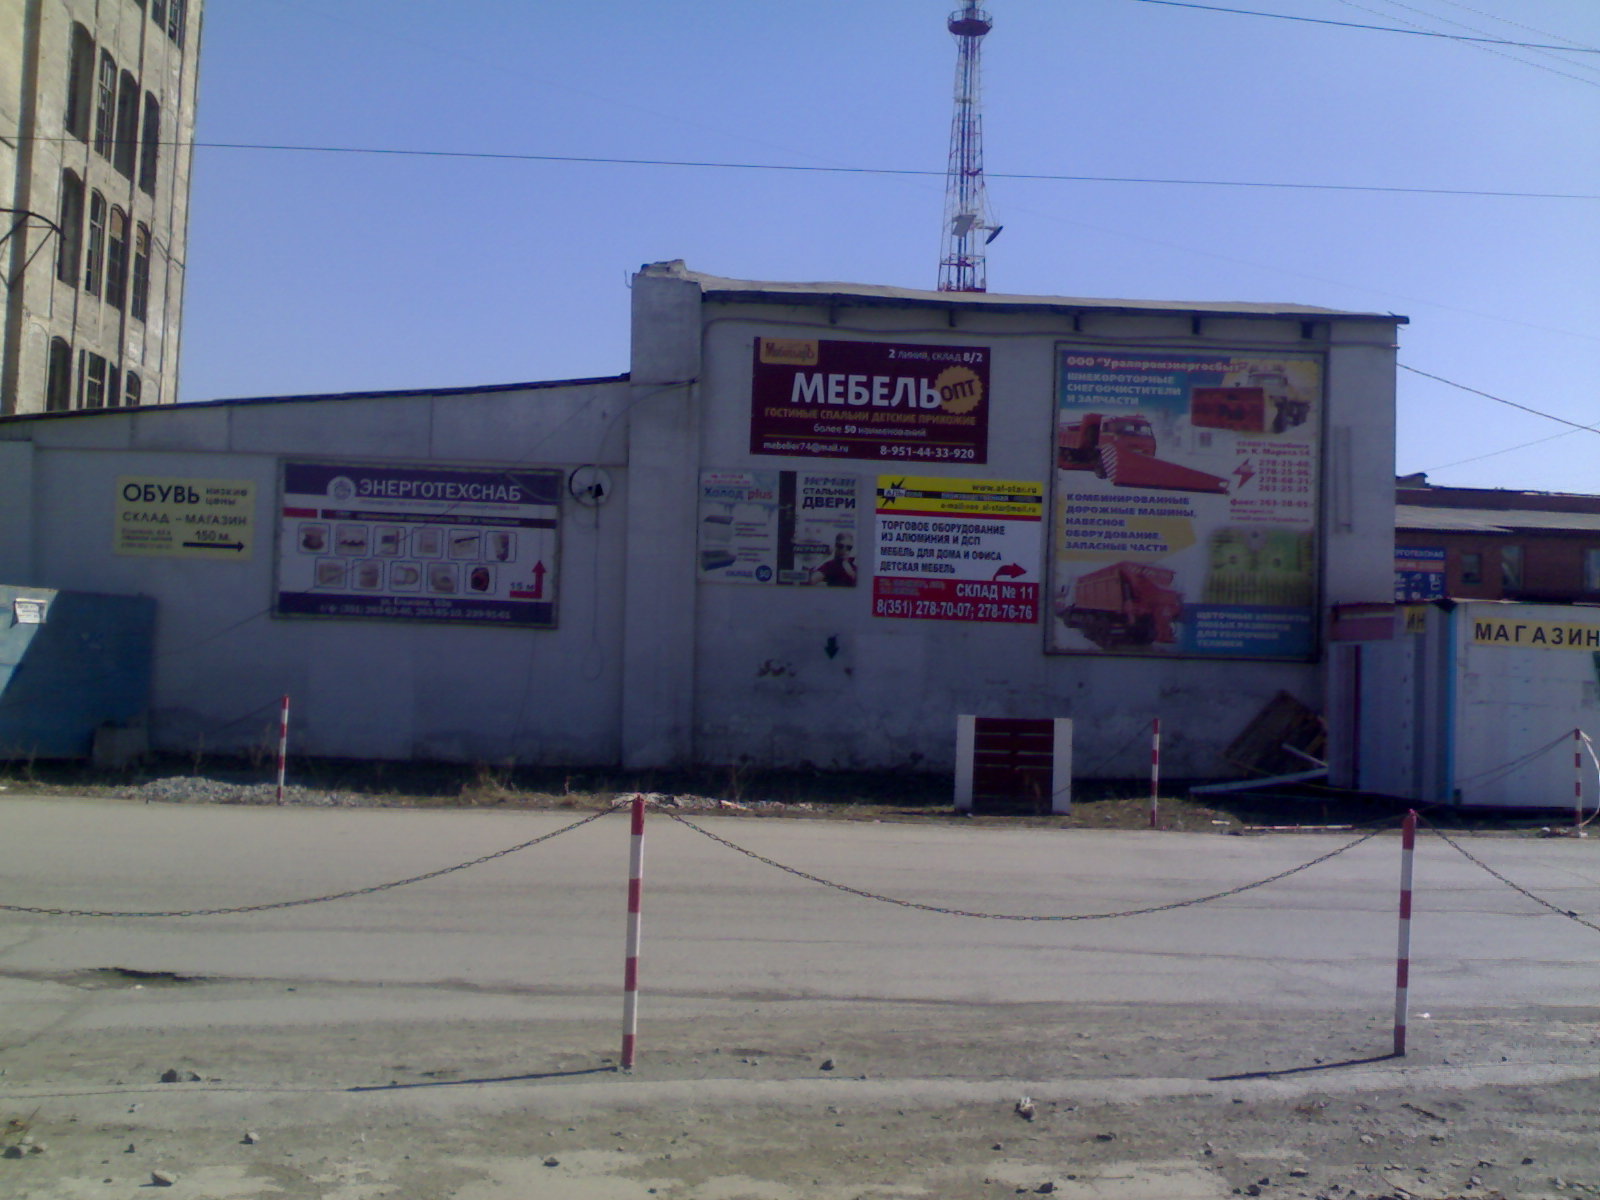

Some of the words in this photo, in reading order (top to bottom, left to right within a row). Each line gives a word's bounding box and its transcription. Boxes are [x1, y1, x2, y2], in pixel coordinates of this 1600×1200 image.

[888, 349, 896, 359] 2
[1067, 356, 1095, 367] ООО
[791, 371, 943, 410] МЕБЕЛЬ
[940, 379, 977, 402] ОПТ
[844, 425, 857, 435] 50
[880, 446, 975, 460] 8-951-44-33-920
[123, 483, 200, 504] ОБУВЬ
[359, 479, 521, 502] ЭНЕРГОТЕХСНАБ
[802, 496, 856, 510] ДВЕРИ
[1066, 505, 1136, 515] ДОРОЖНЫЕ
[123, 511, 170, 524] СКЛАД
[185, 514, 247, 525] МАГАЗИН
[881, 520, 929, 532] ТОРГОВОЕ
[932, 522, 1005, 535] ОБОРУДОВАНИЕ
[881, 532, 893, 542] ИЗ
[895, 533, 950, 545] АЛЮМИНИЯ
[952, 535, 959, 544] И
[961, 535, 981, 547] ДСП
[880, 546, 915, 557] МЕБЕЛЬ
[917, 548, 934, 559] ДЛЯ
[936, 549, 961, 560] ДОМА
[963, 551, 970, 560] И
[972, 551, 1002, 561] ОФИСА
[1130, 543, 1168, 552] ЧАСТИ
[879, 561, 919, 573] ДЕТСКАЯ
[921, 563, 956, 574] МЕБЕЛЬ
[956, 583, 998, 600] СКЛАД
[1001, 586, 1016, 599] №
[1019, 586, 1033, 599] 11
[876, 598, 913, 618] 8(351)
[977, 603, 1033, 620] 278-76-76
[1475, 622, 1600, 647] МАГАЗИН
